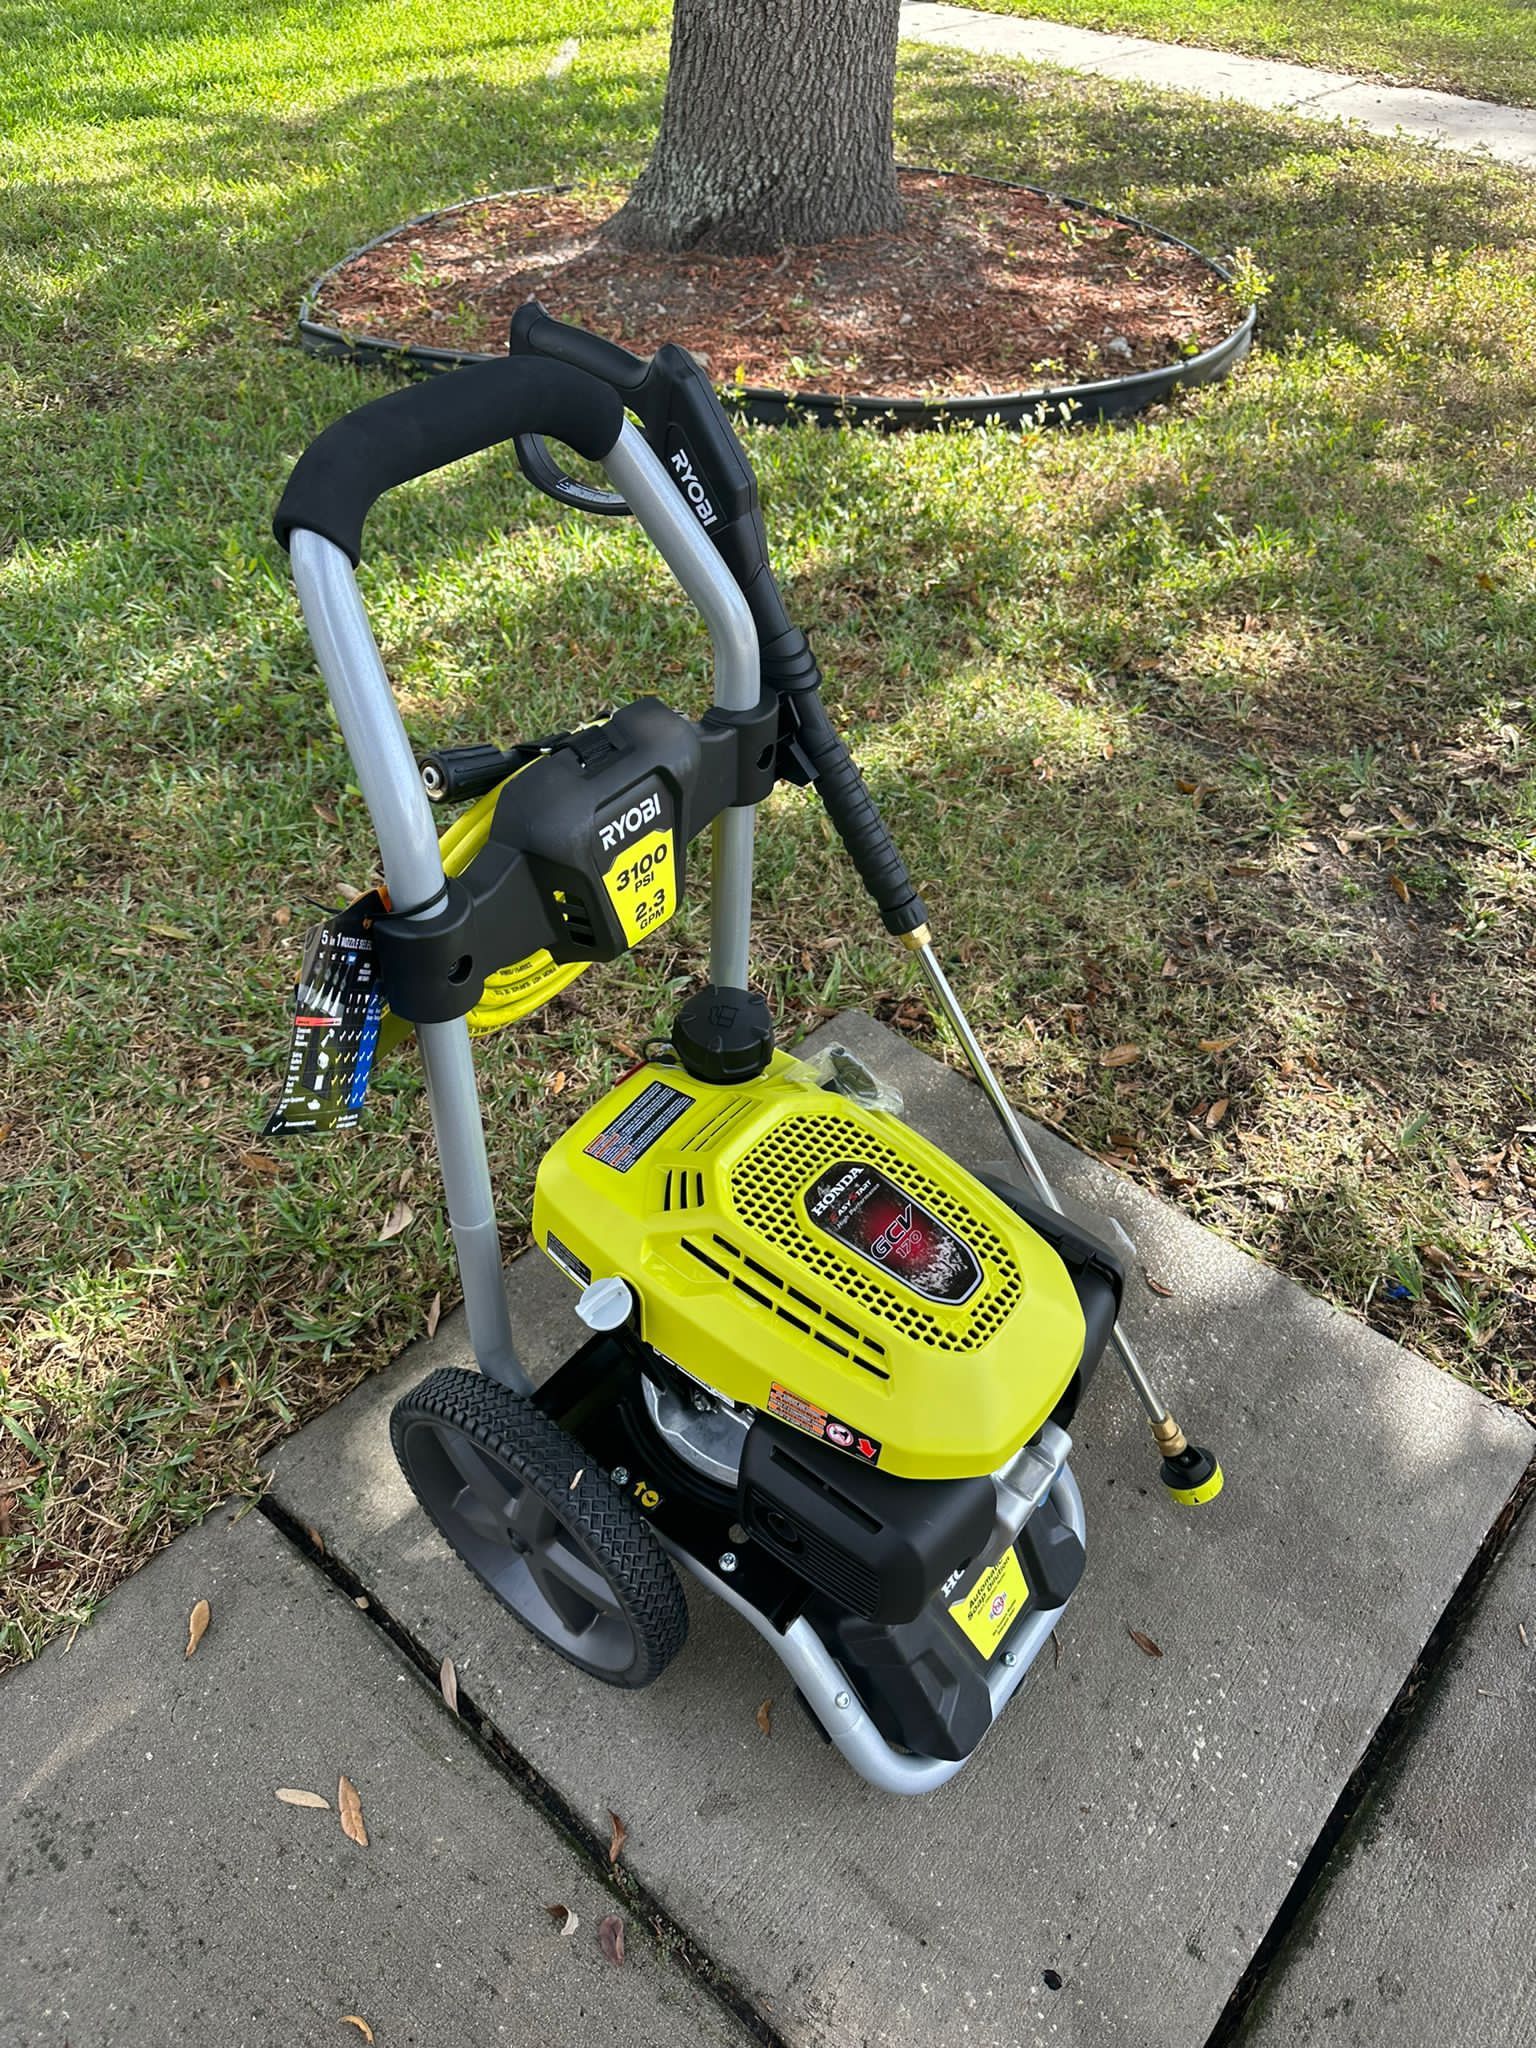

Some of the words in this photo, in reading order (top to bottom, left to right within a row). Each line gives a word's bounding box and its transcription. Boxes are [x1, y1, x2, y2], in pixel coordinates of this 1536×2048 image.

[671, 449, 718, 527] RYOBI
[599, 792, 661, 851] RYOBI
[617, 844, 667, 891] 3100
[634, 872, 654, 892] PSI
[635, 889, 665, 921] 2.3
[640, 907, 665, 930] GPM
[321, 929, 329, 945] 5
[336, 932, 343, 947] 1
[811, 1166, 865, 1217] HONDA
[871, 1204, 912, 1260] GCV
[895, 1229, 923, 1259] 170
[967, 1594, 987, 1621] Soap
[986, 1555, 1011, 1592] Dilution
